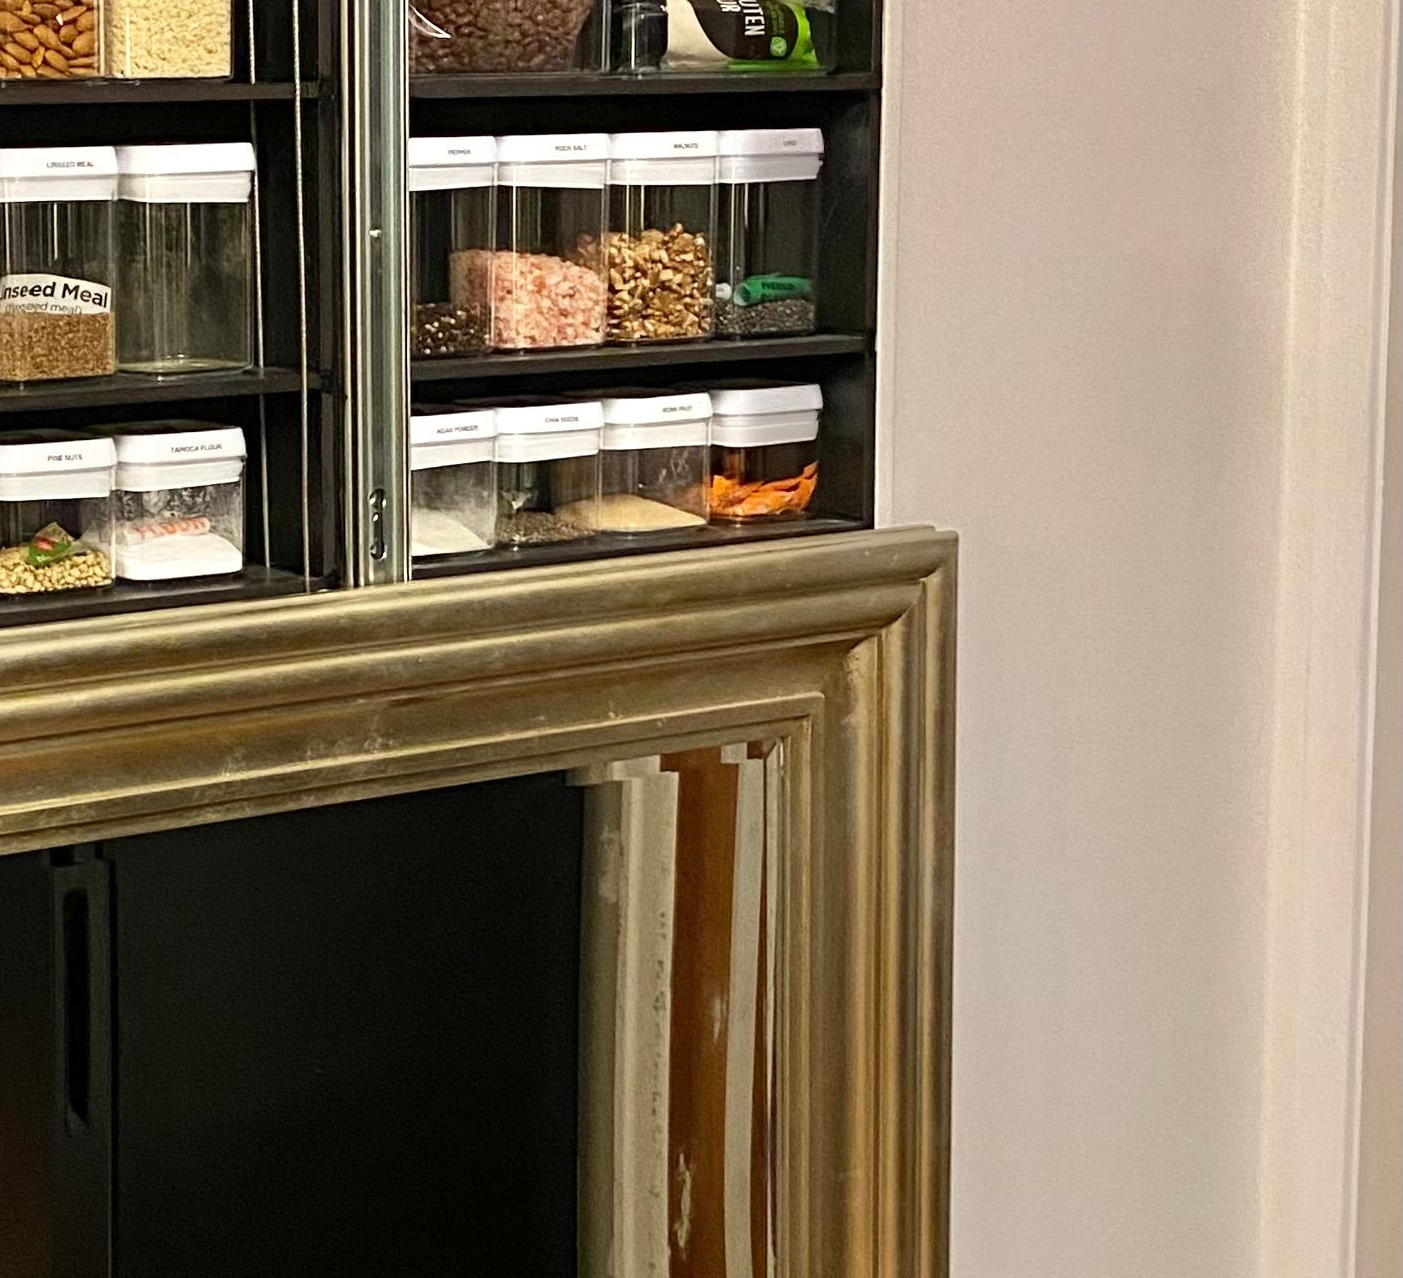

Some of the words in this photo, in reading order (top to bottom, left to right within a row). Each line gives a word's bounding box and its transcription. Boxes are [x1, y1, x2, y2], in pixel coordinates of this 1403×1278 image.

[61, 283, 108, 309] Meal
[171, 445, 199, 455] TAPIOCA
[200, 443, 223, 451] FLOUR
[64, 453, 83, 461] NUTS
